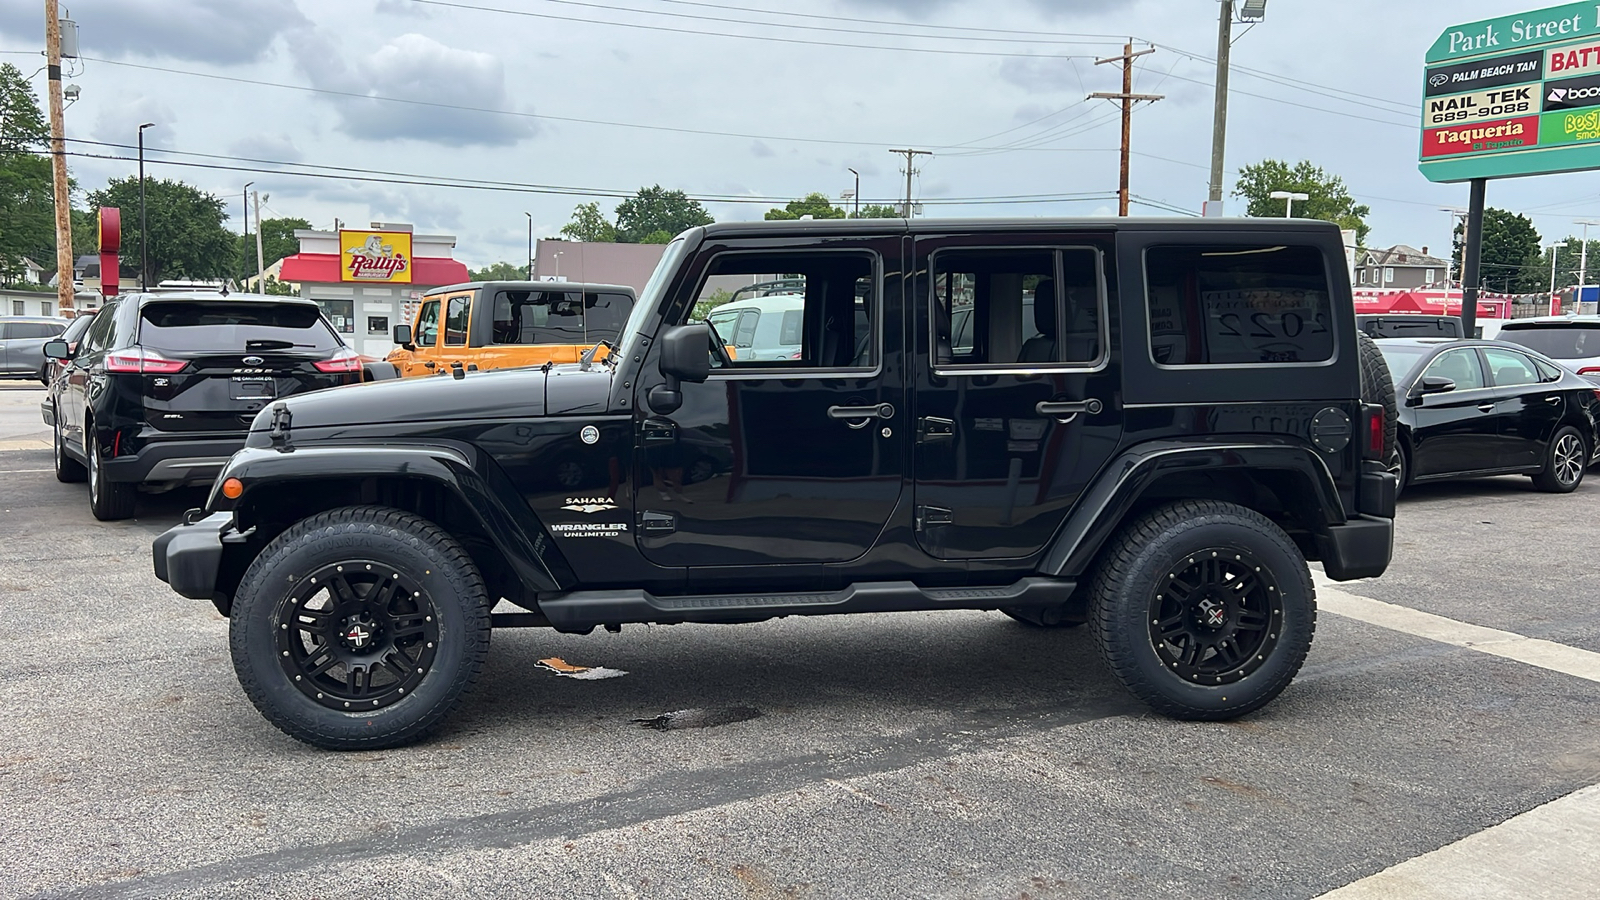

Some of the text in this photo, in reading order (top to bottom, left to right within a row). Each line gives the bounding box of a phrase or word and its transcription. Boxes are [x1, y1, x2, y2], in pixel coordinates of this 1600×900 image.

[1448, 25, 1500, 54] Park
[1511, 13, 1581, 43] Street
[1451, 60, 1537, 83] PALM BEACH TAN
[1431, 87, 1531, 113] NAIL TEK
[1432, 102, 1529, 124] 689-9088
[1473, 142, 1483, 150] El
[348, 253, 406, 278] Rally's
[551, 523, 628, 531] WRANGLER
